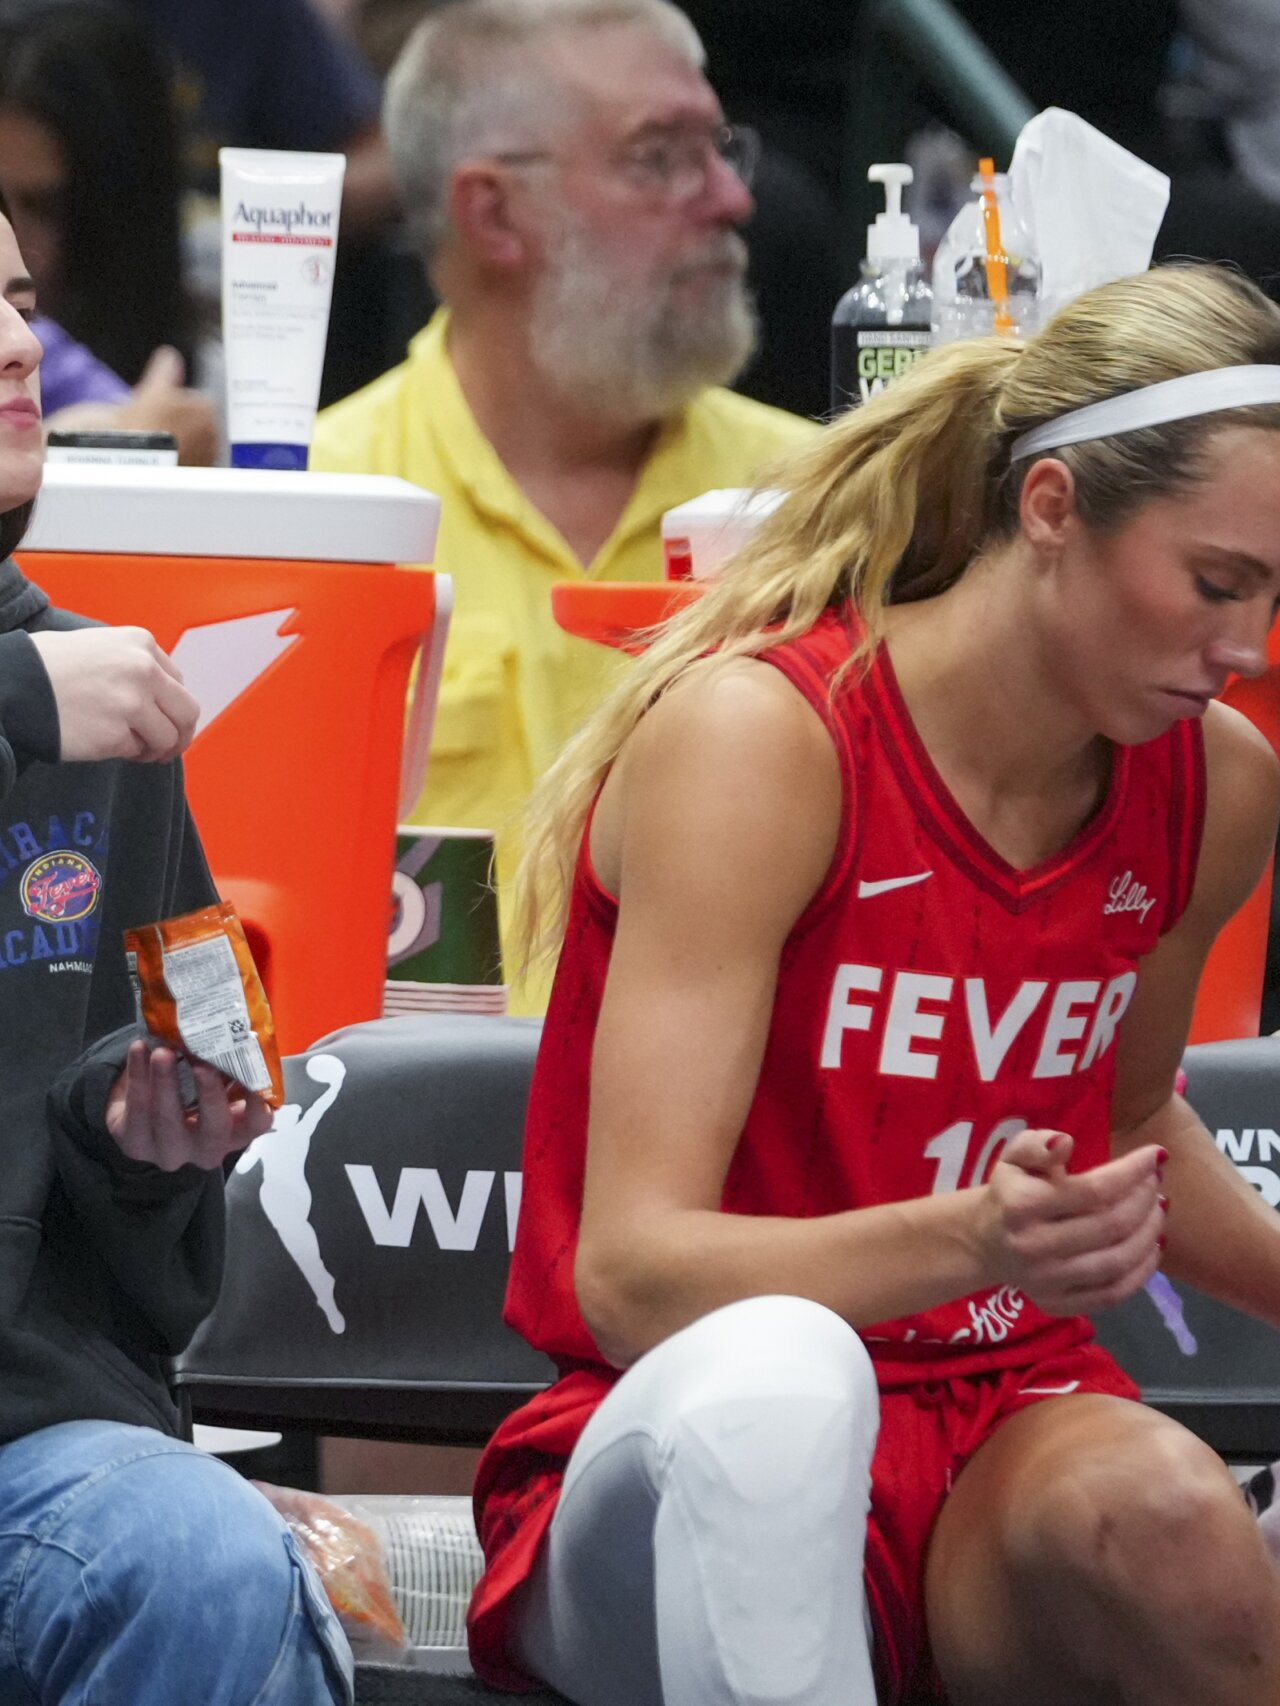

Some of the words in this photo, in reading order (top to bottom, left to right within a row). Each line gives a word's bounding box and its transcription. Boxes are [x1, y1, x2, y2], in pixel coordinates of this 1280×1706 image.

[233, 201, 332, 233] Aquaphor
[28, 868, 100, 918] Fever
[31, 857, 84, 882] INDIANA
[1103, 870, 1156, 924] Lilly
[819, 963, 1138, 1082] FEVER
